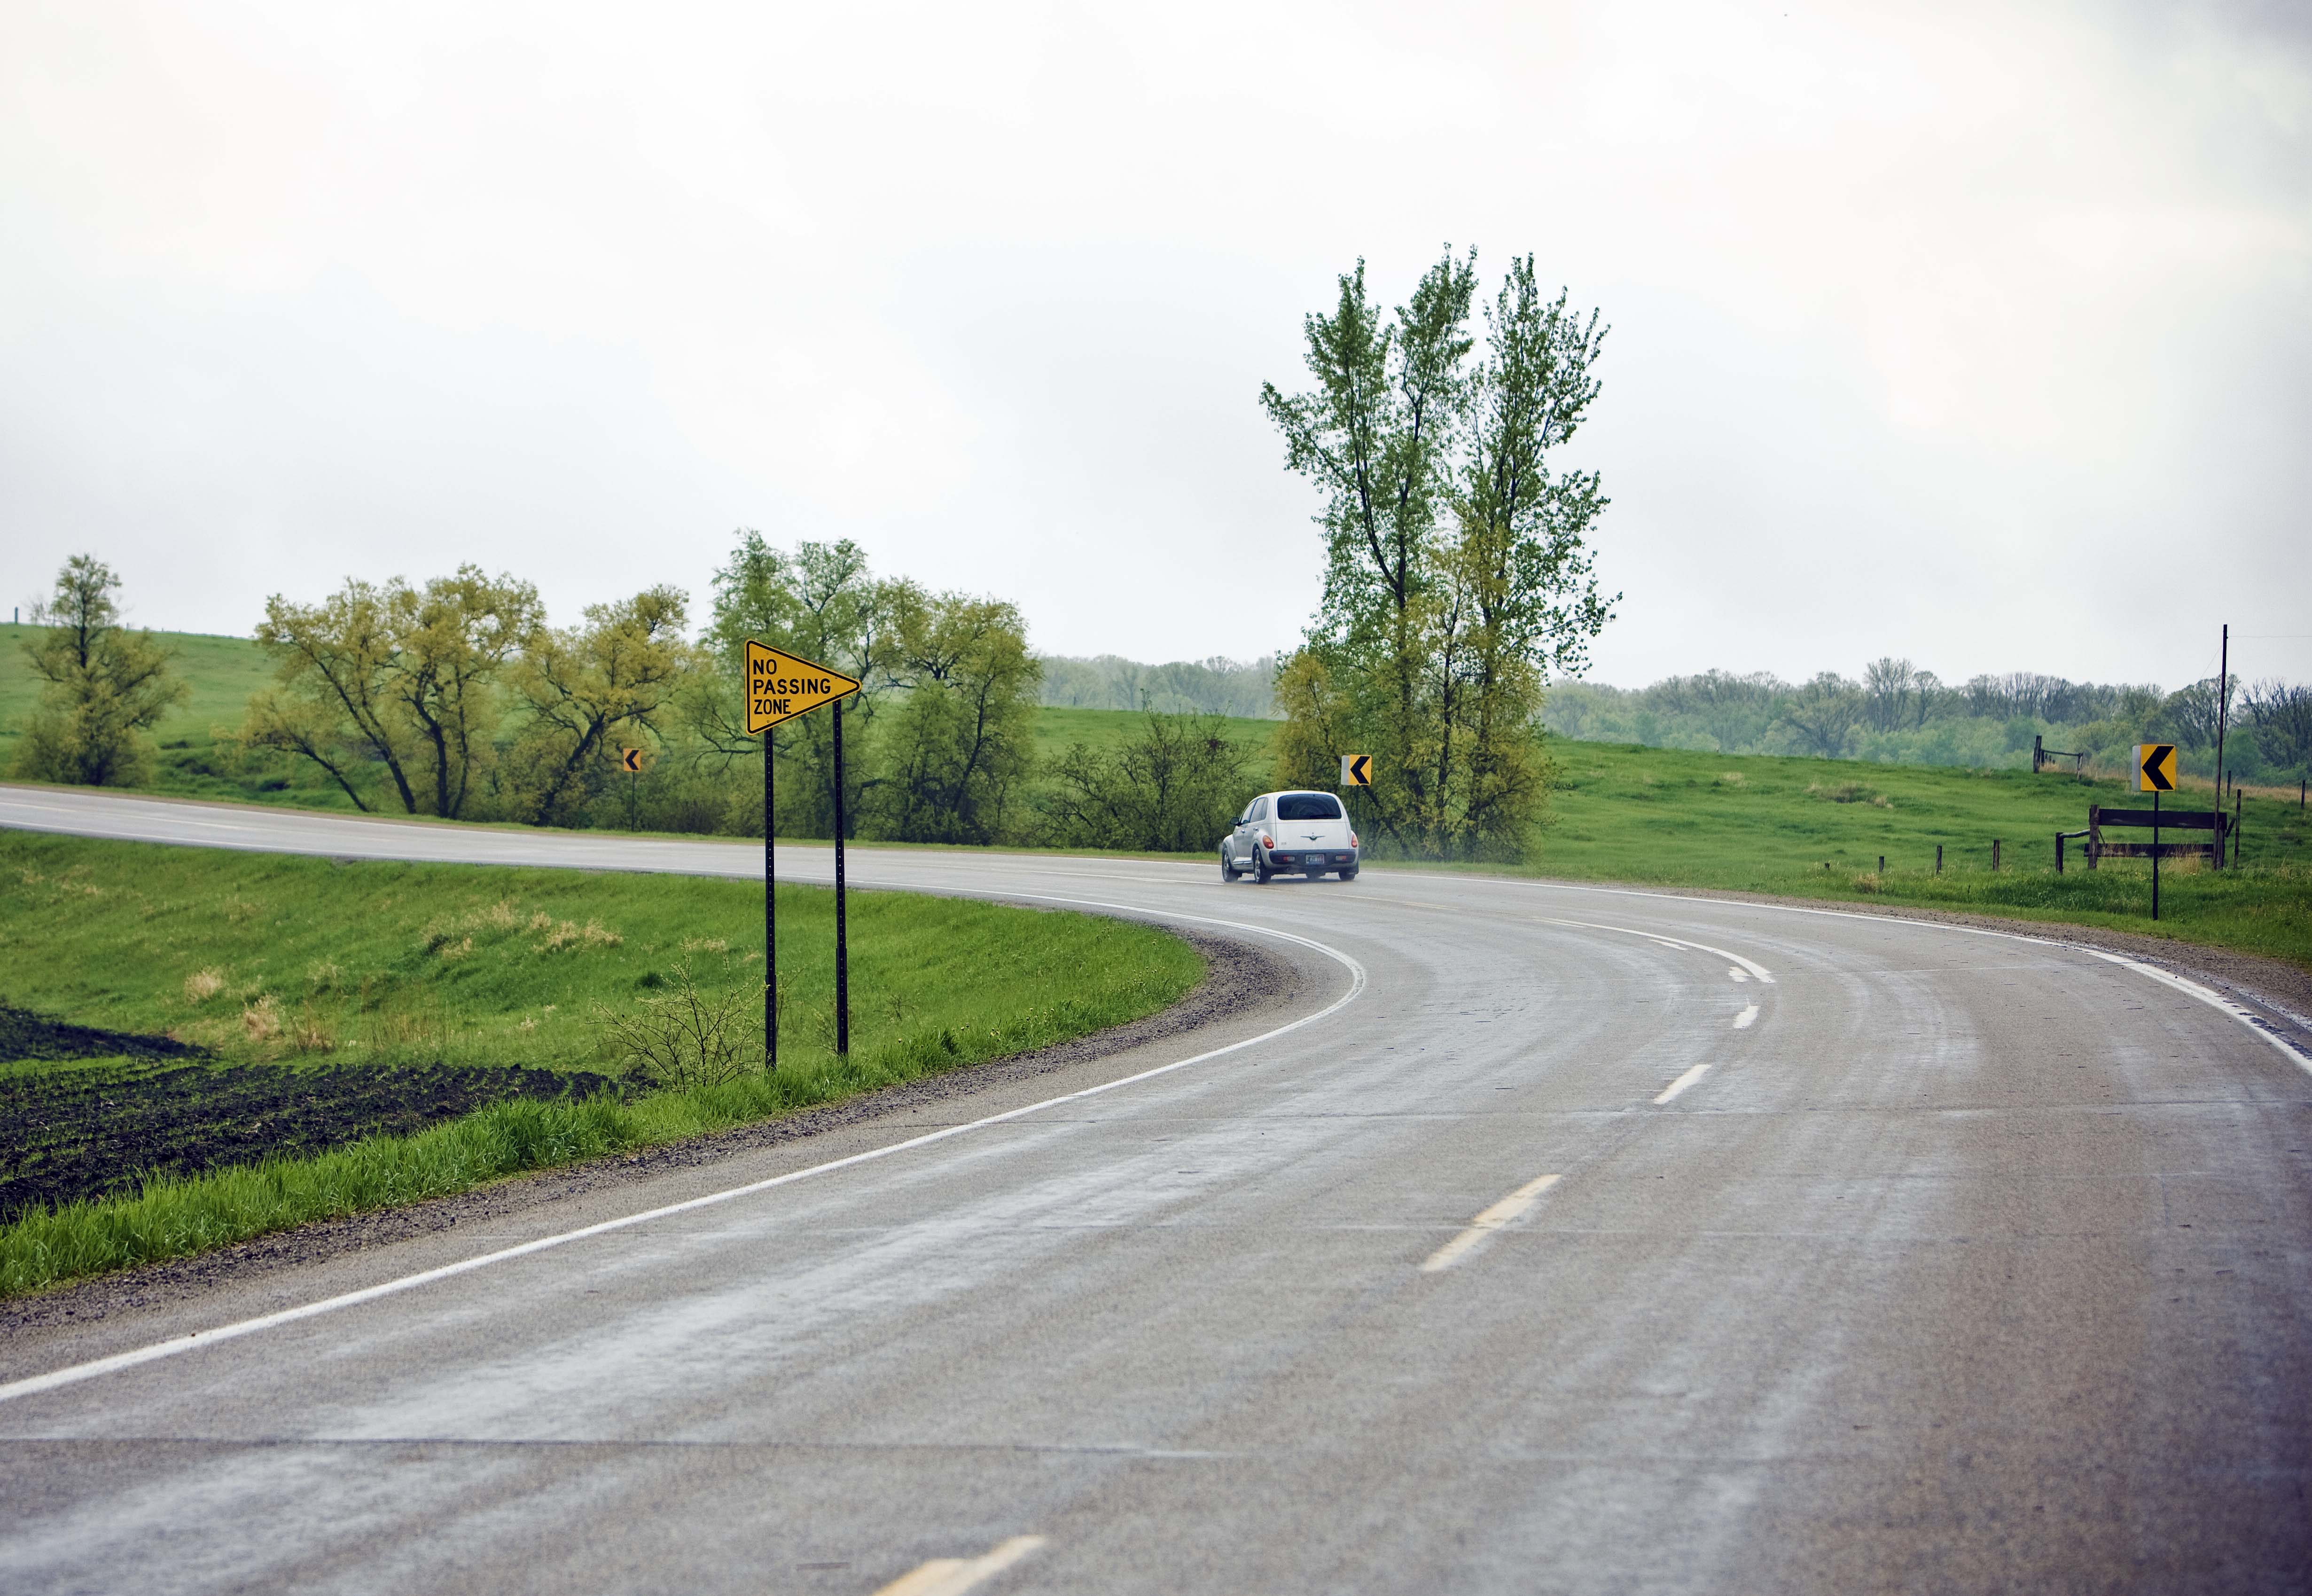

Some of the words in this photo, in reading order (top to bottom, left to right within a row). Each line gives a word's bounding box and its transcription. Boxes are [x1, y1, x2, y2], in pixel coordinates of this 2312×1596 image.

[753, 659, 777, 675] NO
[753, 678, 831, 695] PASSING
[754, 699, 791, 714] ZONE
